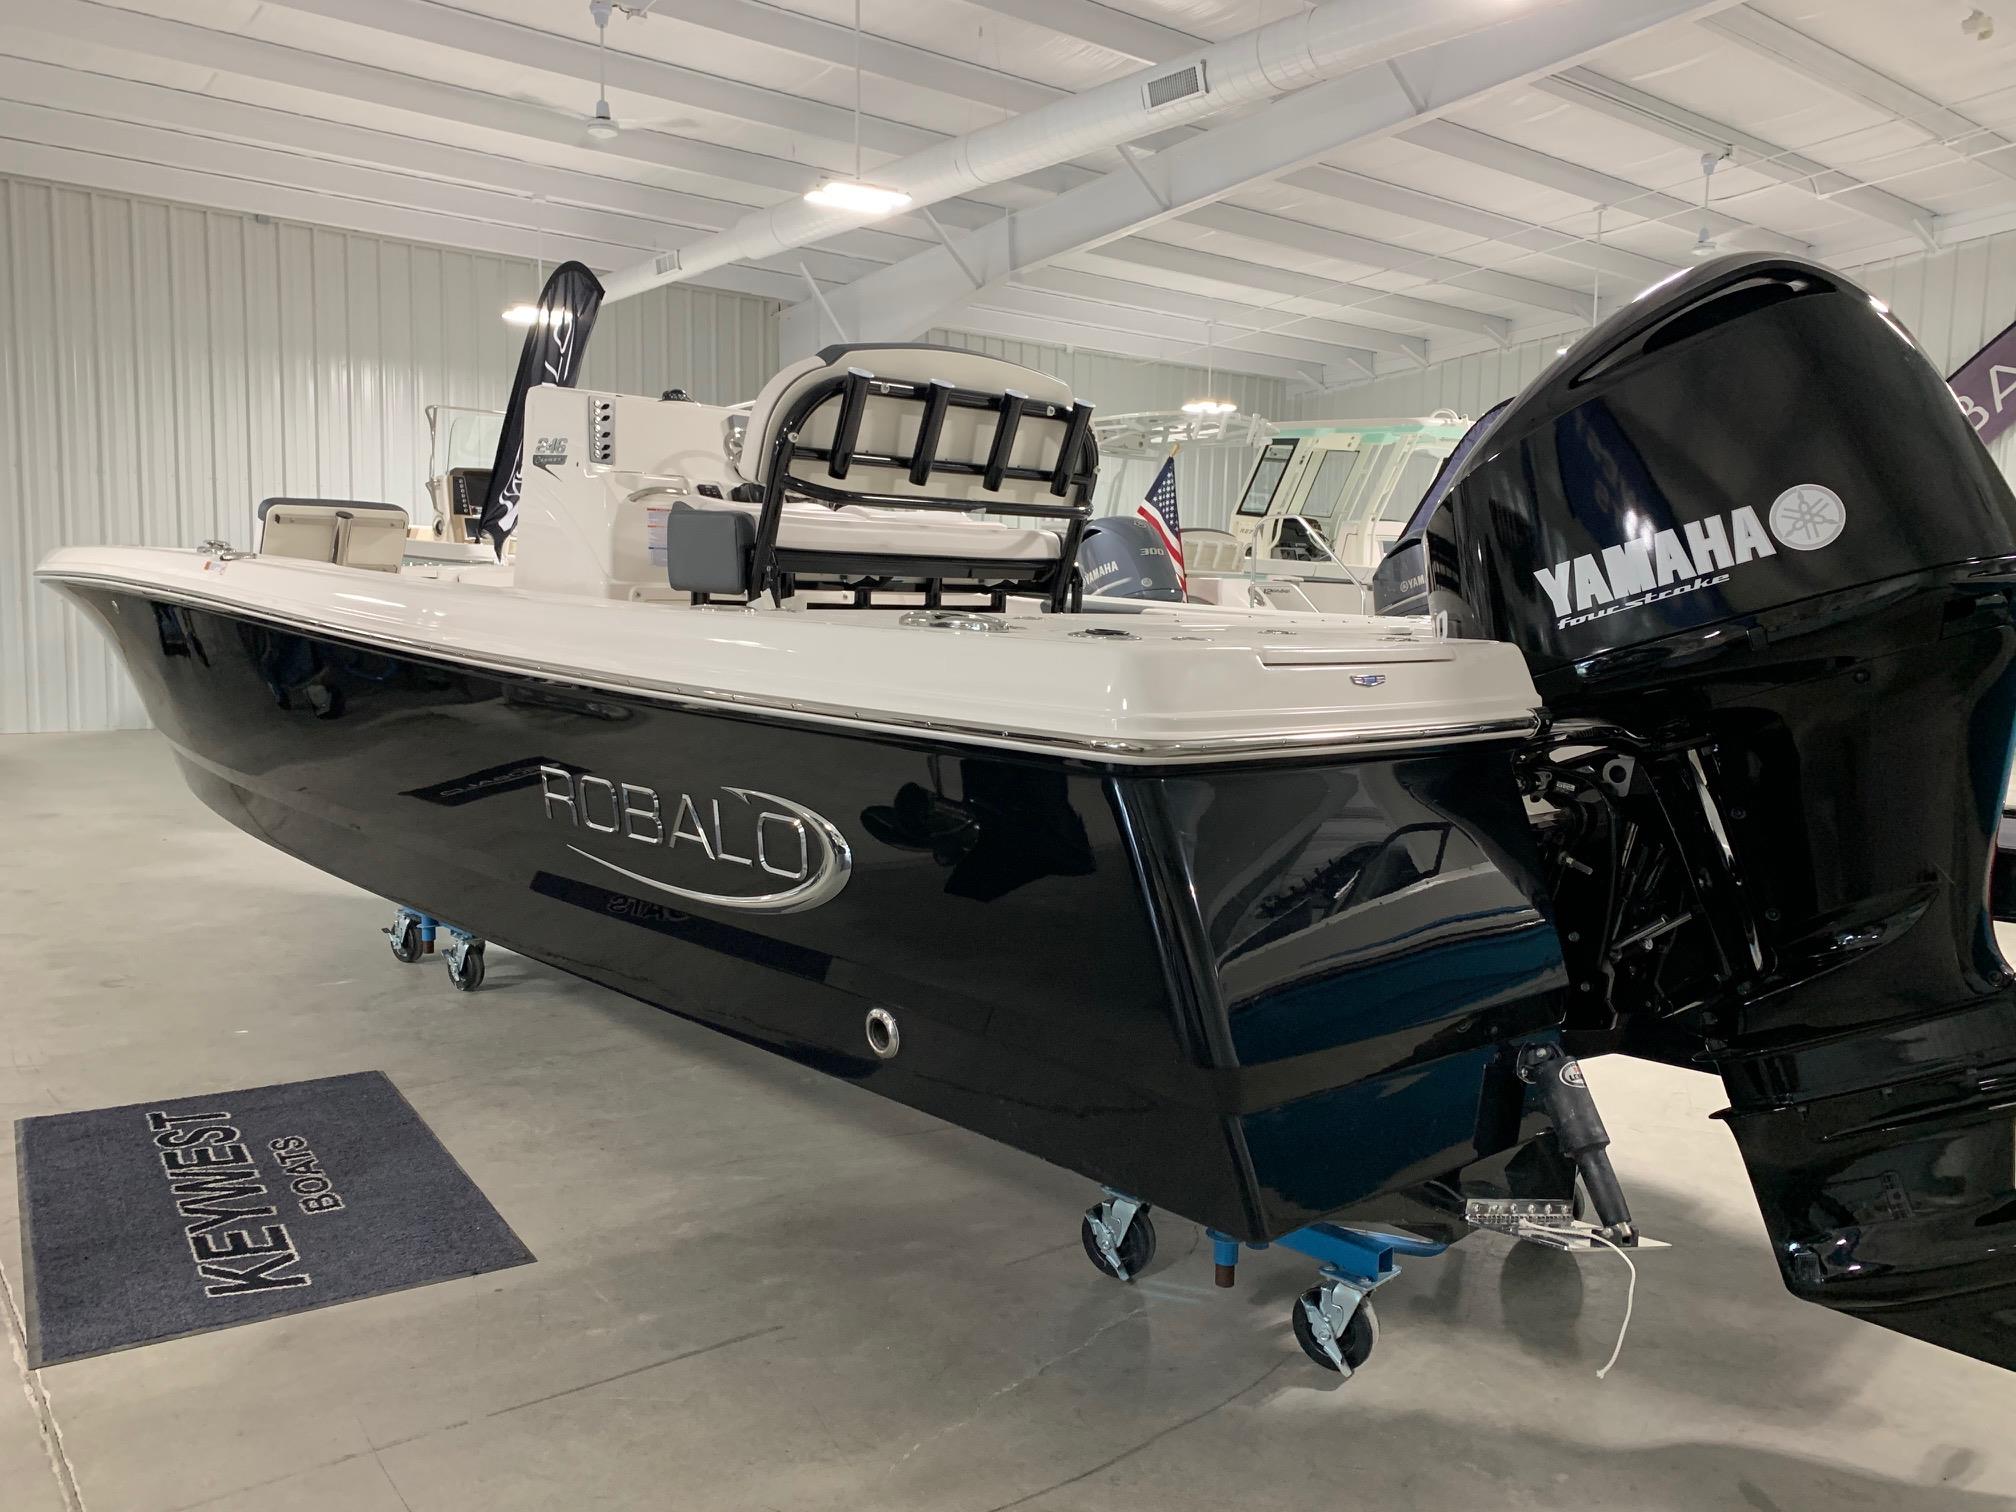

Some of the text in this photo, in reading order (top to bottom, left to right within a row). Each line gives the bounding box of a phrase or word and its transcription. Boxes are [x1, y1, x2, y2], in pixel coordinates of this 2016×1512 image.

[535, 437, 568, 454] 246
[1084, 560, 1119, 585] YAMAHA
[1140, 547, 1164, 556] 300
[1533, 505, 1777, 617] YAMAHA
[540, 764, 808, 881] ROBALO
[268, 1135, 346, 1215] BOATS
